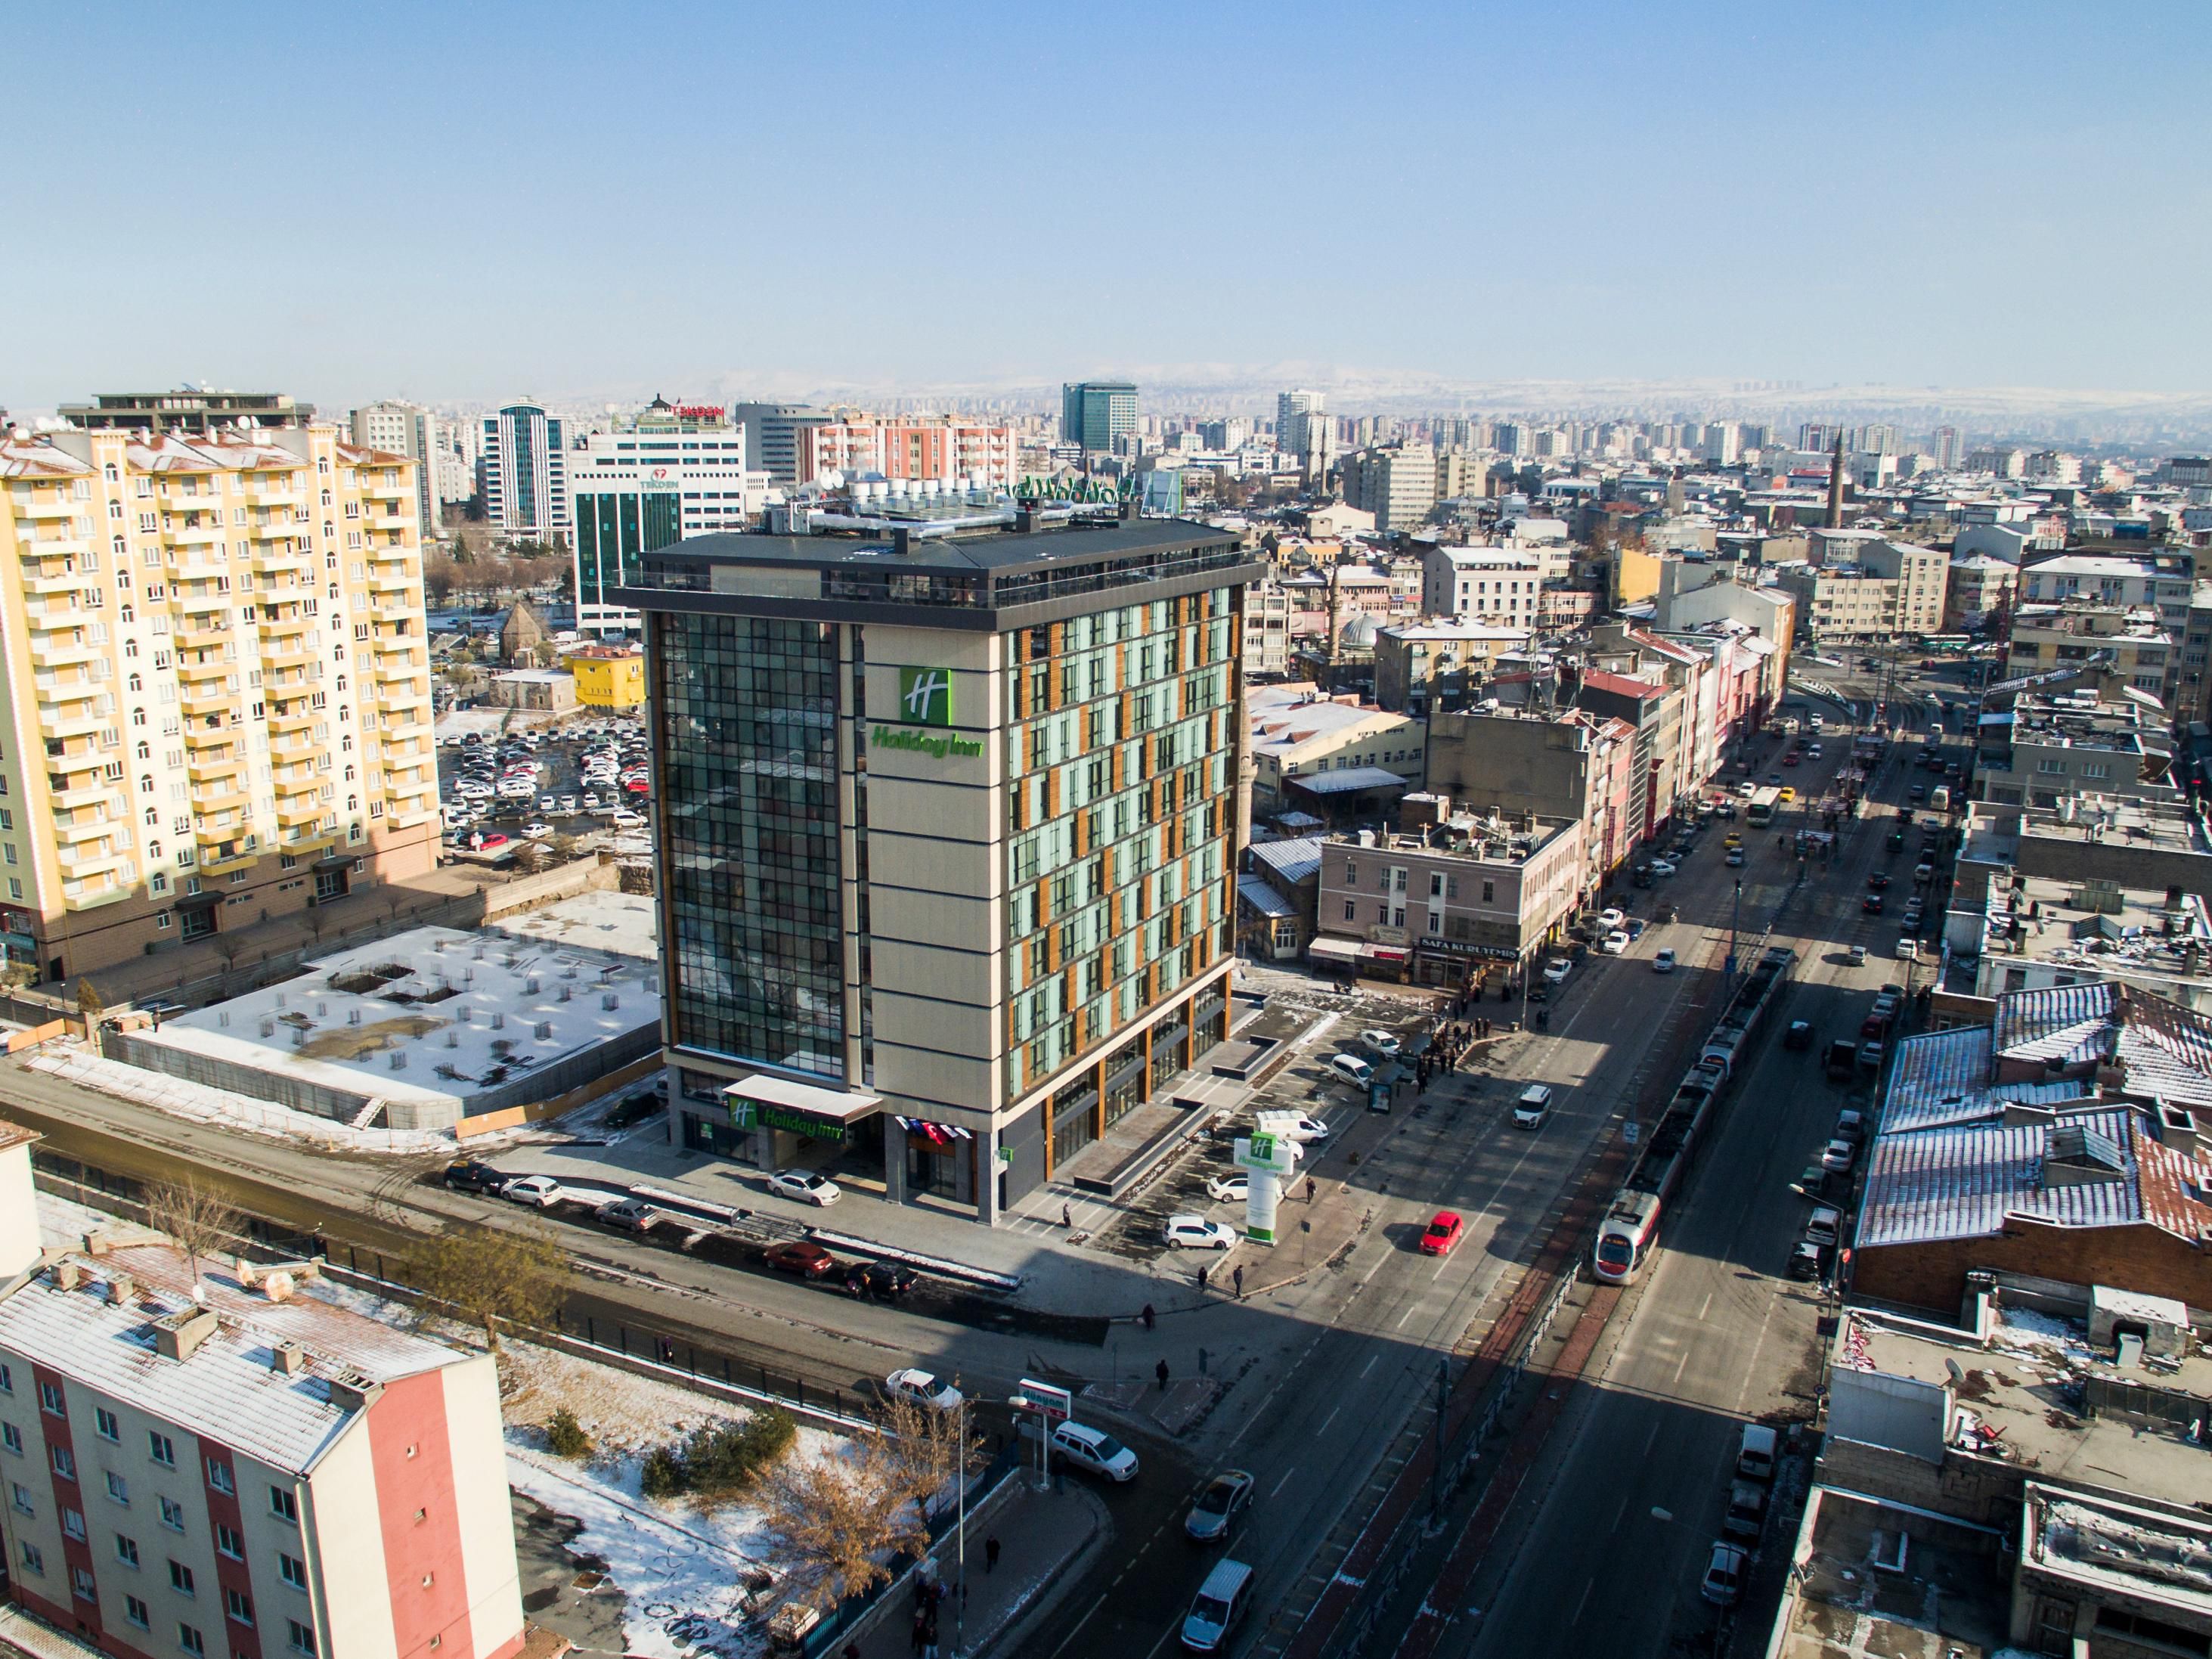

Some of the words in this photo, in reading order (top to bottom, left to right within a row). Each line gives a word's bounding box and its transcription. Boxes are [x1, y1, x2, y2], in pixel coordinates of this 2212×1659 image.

[671, 405, 725, 417] TEKDEN
[640, 480, 680, 488] TEKDEN
[872, 725, 949, 758] Holiday
[949, 732, 984, 757] Inn
[1421, 938, 1450, 950] SAFA
[764, 1109, 816, 1137] Holiday
[818, 1120, 844, 1139] Inn
[1238, 1155, 1270, 1171] Holiday
